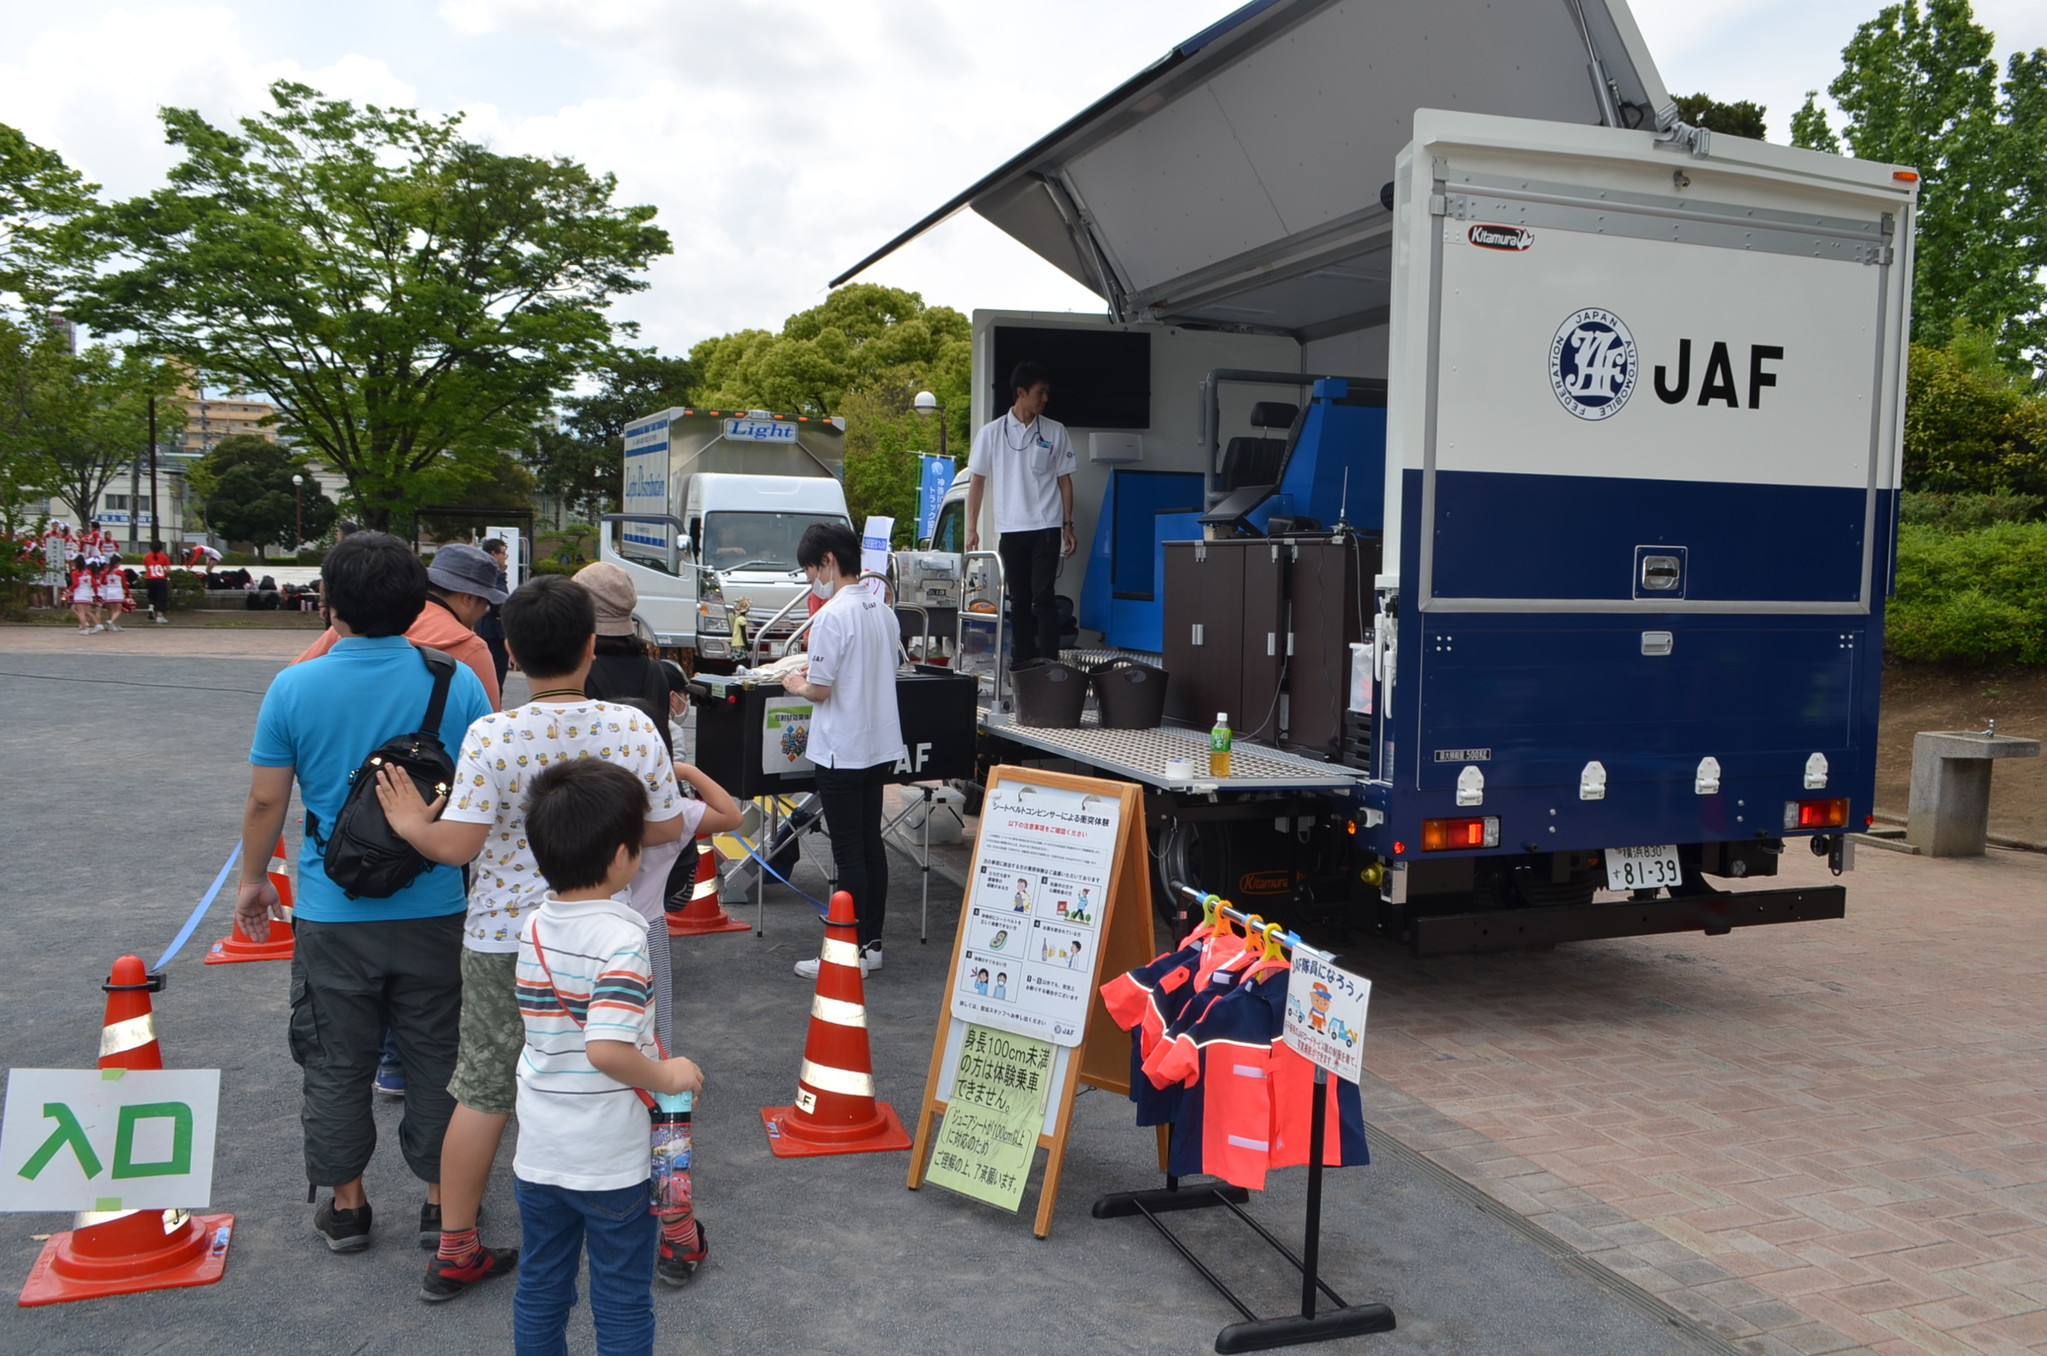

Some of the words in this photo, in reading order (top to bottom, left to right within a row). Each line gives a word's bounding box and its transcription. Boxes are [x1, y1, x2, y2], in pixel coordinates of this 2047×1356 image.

[1471, 227, 1518, 246] Kitamura
[1576, 311, 1618, 327] JAPAN
[1552, 336, 1586, 416] FEDERATION
[1599, 340, 1636, 416] AUTOMOBILE
[1654, 338, 1785, 410] JAF
[731, 421, 793, 439] Light
[888, 742, 932, 775] AF
[992, 802, 1110, 827] シートベルトコンビンサーによる衝突体験
[1008, 820, 1088, 837] 以下の注意事項をご確認ください
[1624, 860, 1677, 885] 81-39
[1062, 1028, 1075, 1036] JAF
[965, 1029, 1050, 1070] 身長100cm未満
[961, 1055, 1039, 1092] の方は体験乗車
[958, 1079, 1010, 1112] できません。
[17, 1102, 193, 1180] 入口
